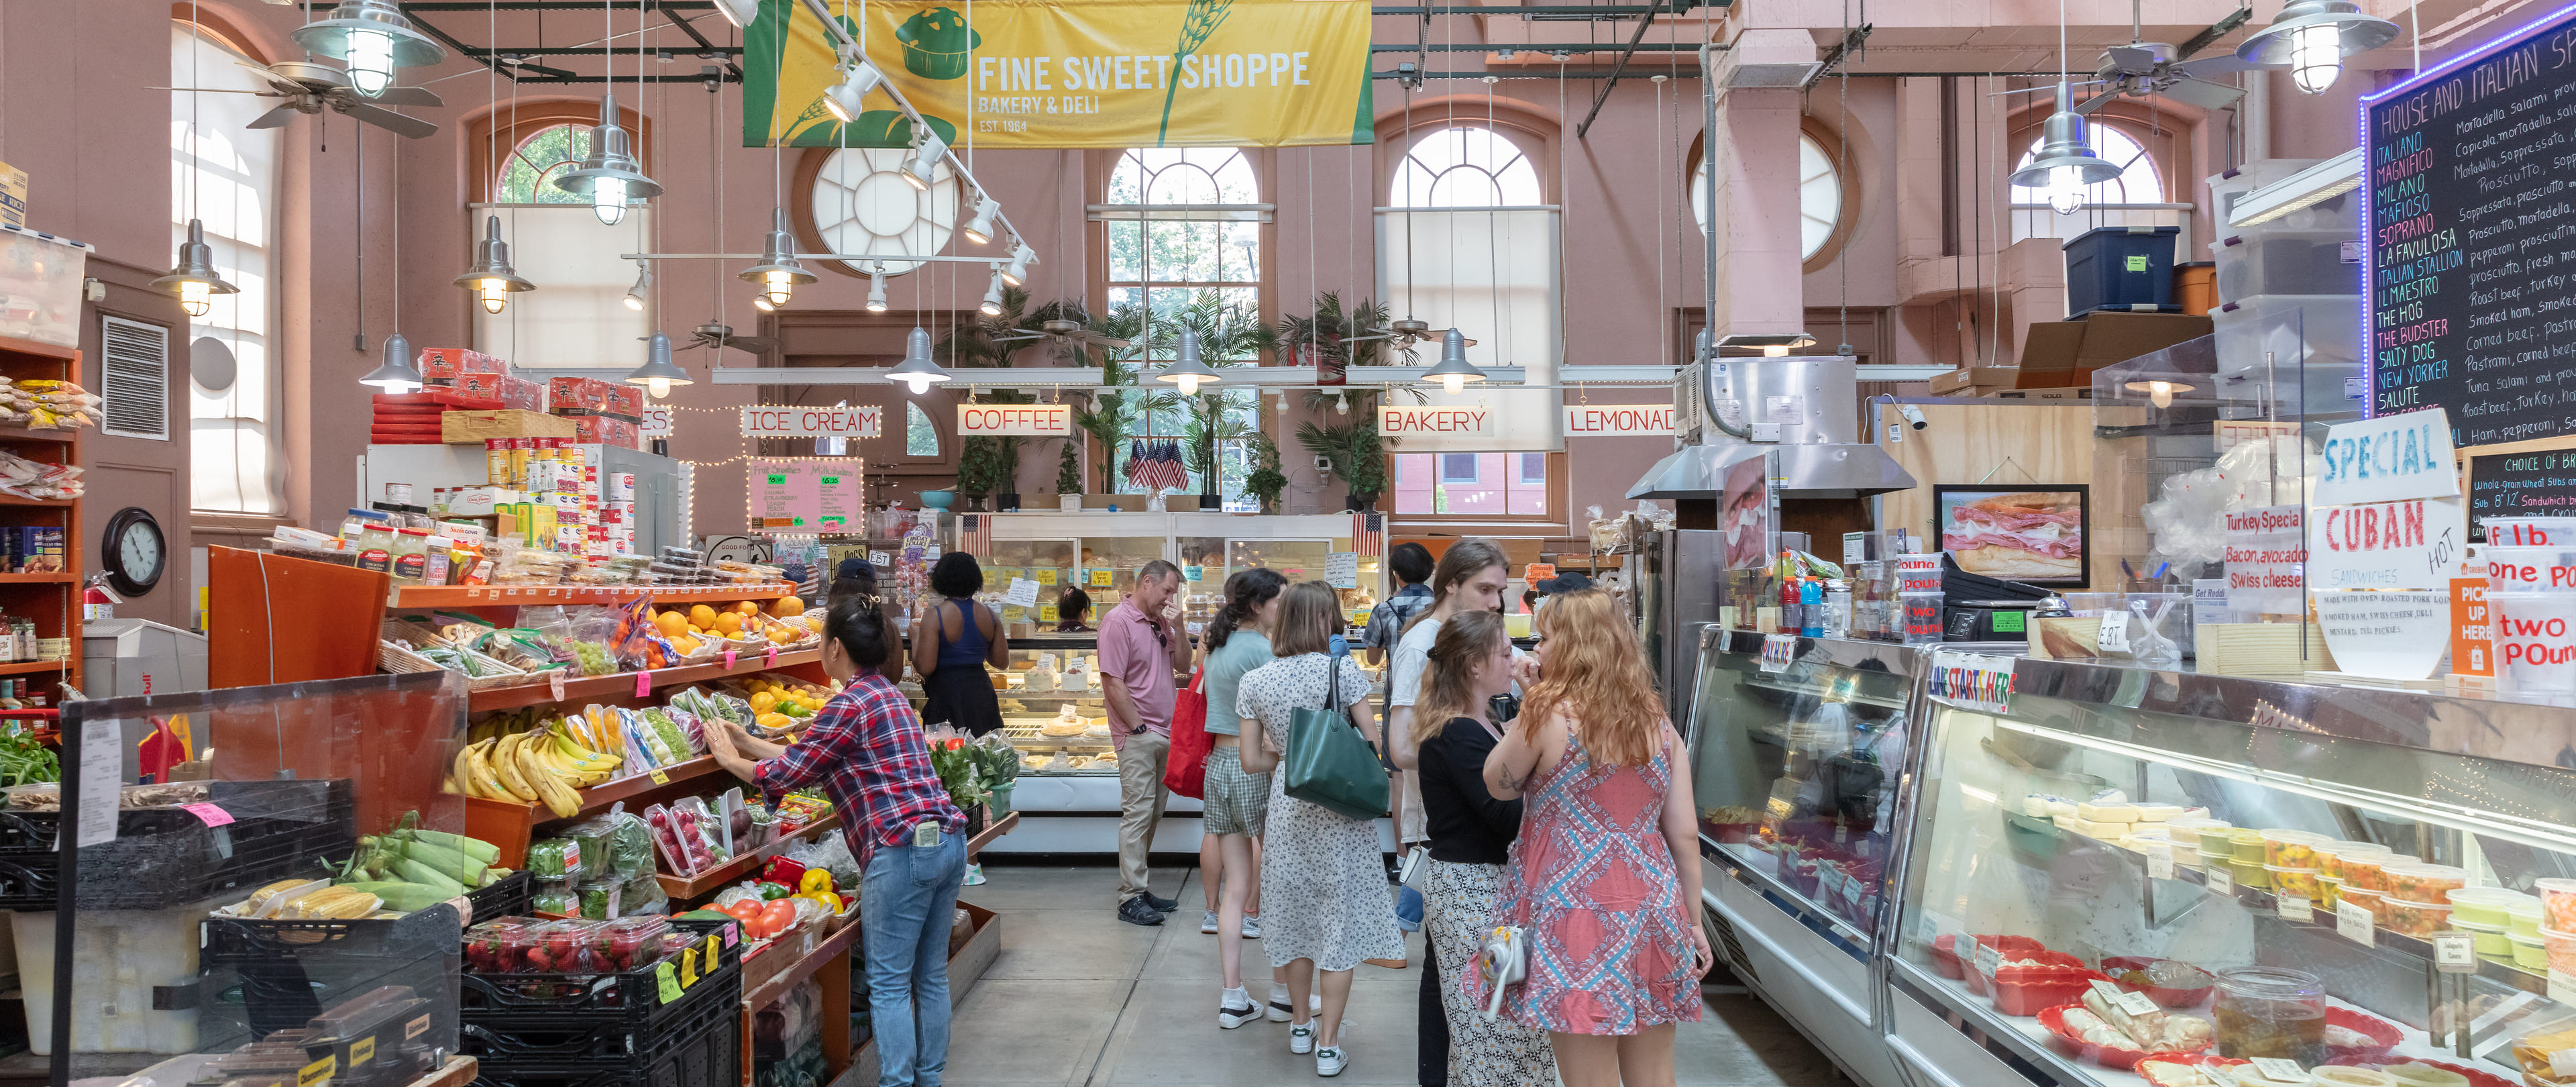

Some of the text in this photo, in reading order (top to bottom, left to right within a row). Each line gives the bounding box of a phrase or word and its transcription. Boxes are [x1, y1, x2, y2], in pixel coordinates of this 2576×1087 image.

[978, 52, 1310, 92] FINE SWEET SHOPPE
[2381, 44, 2538, 139] HOUSE AND ITALIAN
[978, 95, 1099, 115] BAKERY & DELI
[2457, 88, 2547, 136] Mortadella Salami
[979, 120, 1028, 133] EST. 1964
[2376, 132, 2422, 167] ITALIANO
[2377, 148, 2432, 187] MAGNIFICO
[2377, 173, 2424, 207] MILANO
[9, 197, 24, 211] RICE
[2378, 193, 2430, 227] MAFIOSO
[2379, 213, 2434, 246] SOPRANO
[2378, 227, 2457, 268] LA FAVULOSA
[2470, 242, 2515, 268] pepperoni
[2378, 248, 2463, 288] ITALIAN STALLION
[2526, 254, 2553, 275] fresh
[2378, 276, 2438, 308] IL MAESTRO
[2377, 301, 2423, 328] THE HOG
[2377, 319, 2448, 349] THE BUDSTER
[2467, 333, 2502, 350] Corned
[2379, 341, 2435, 370] SALTY DOG
[2378, 359, 2448, 389] NEW YORKER
[2465, 370, 2551, 395] Tuna Salami and
[2378, 385, 2420, 410] SALUTE
[749, 411, 875, 432] ICE CREAM
[965, 409, 1064, 430] COFFEE
[1385, 411, 1486, 431] BAKERY
[2324, 424, 2436, 484] SPECIAL
[2505, 453, 2557, 472] CHOICE OF
[754, 465, 801, 475] Fruit Smoothies
[810, 465, 853, 476] Milkshakes
[2547, 477, 2566, 486] Subs
[2473, 499, 2489, 509] Sub
[2522, 495, 2566, 507] Sandwhich
[2226, 508, 2304, 535] Turkey Special
[2326, 501, 2424, 552] CUBAN
[870, 554, 888, 564] EBT
[2260, 544, 2308, 564] avocado
[2428, 527, 2453, 574] HOT
[2231, 572, 2260, 589] Swiss
[2331, 569, 2398, 586] SANDWICHES
[2489, 562, 2538, 582] one
[2196, 588, 2224, 598] Get Reddi
[2324, 596, 2340, 604] MADE
[2342, 595, 2358, 603] WITH
[2381, 594, 2410, 603] ROASTED
[2413, 595, 2430, 603] PORK
[2434, 597, 2451, 605] LOIN
[2462, 586, 2490, 602] PICK
[1905, 605, 1935, 617] two
[2110, 612, 2118, 621] NO
[2351, 613, 2367, 621] HAM,
[2469, 606, 2485, 621] UP
[2099, 626, 2120, 645] EBT
[2361, 627, 2373, 635] DILL
[2462, 625, 2491, 640] HERE
[2500, 615, 2565, 637] two
[1763, 640, 1774, 661] PAY
[1774, 641, 1790, 664] HERE
[1929, 666, 2017, 704] LINE STARTS HERE
